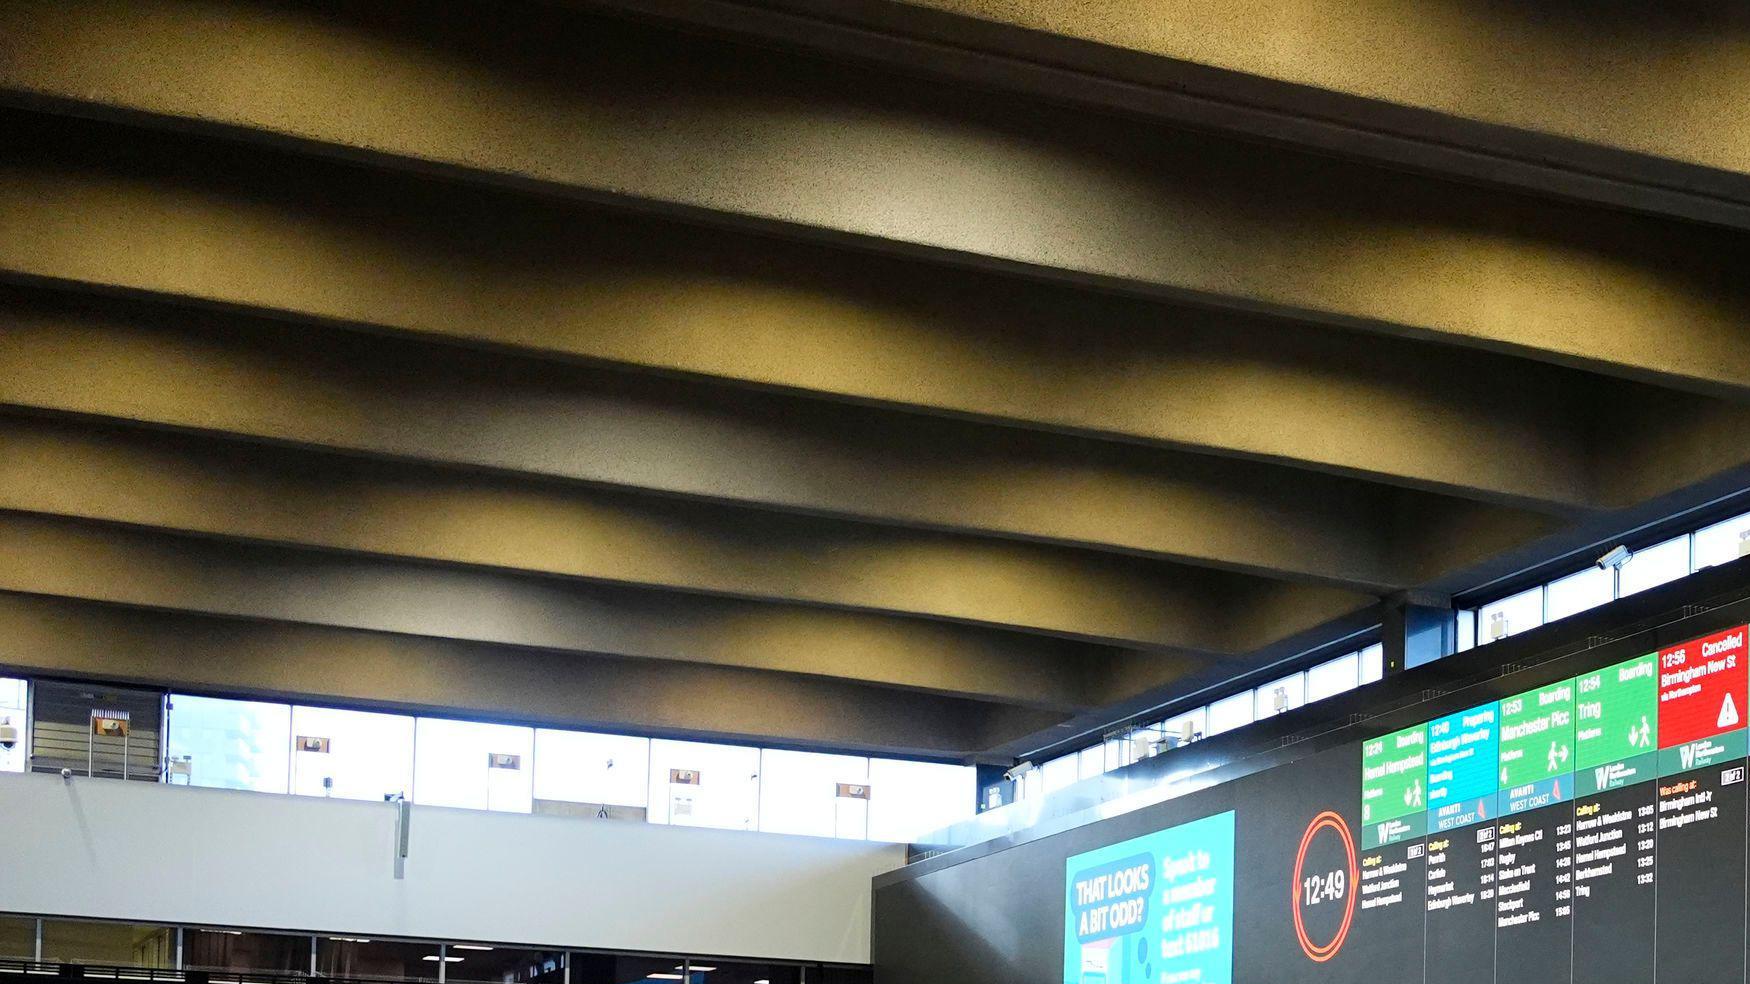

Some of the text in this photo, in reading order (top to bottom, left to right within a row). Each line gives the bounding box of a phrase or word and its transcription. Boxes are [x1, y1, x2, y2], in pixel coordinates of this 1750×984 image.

[1702, 632, 1742, 657] Cancelled
[1076, 864, 1149, 905] THAT LOOKS
[1304, 870, 1345, 906] 12:49
[1080, 897, 1144, 936] A BIT ODD?
